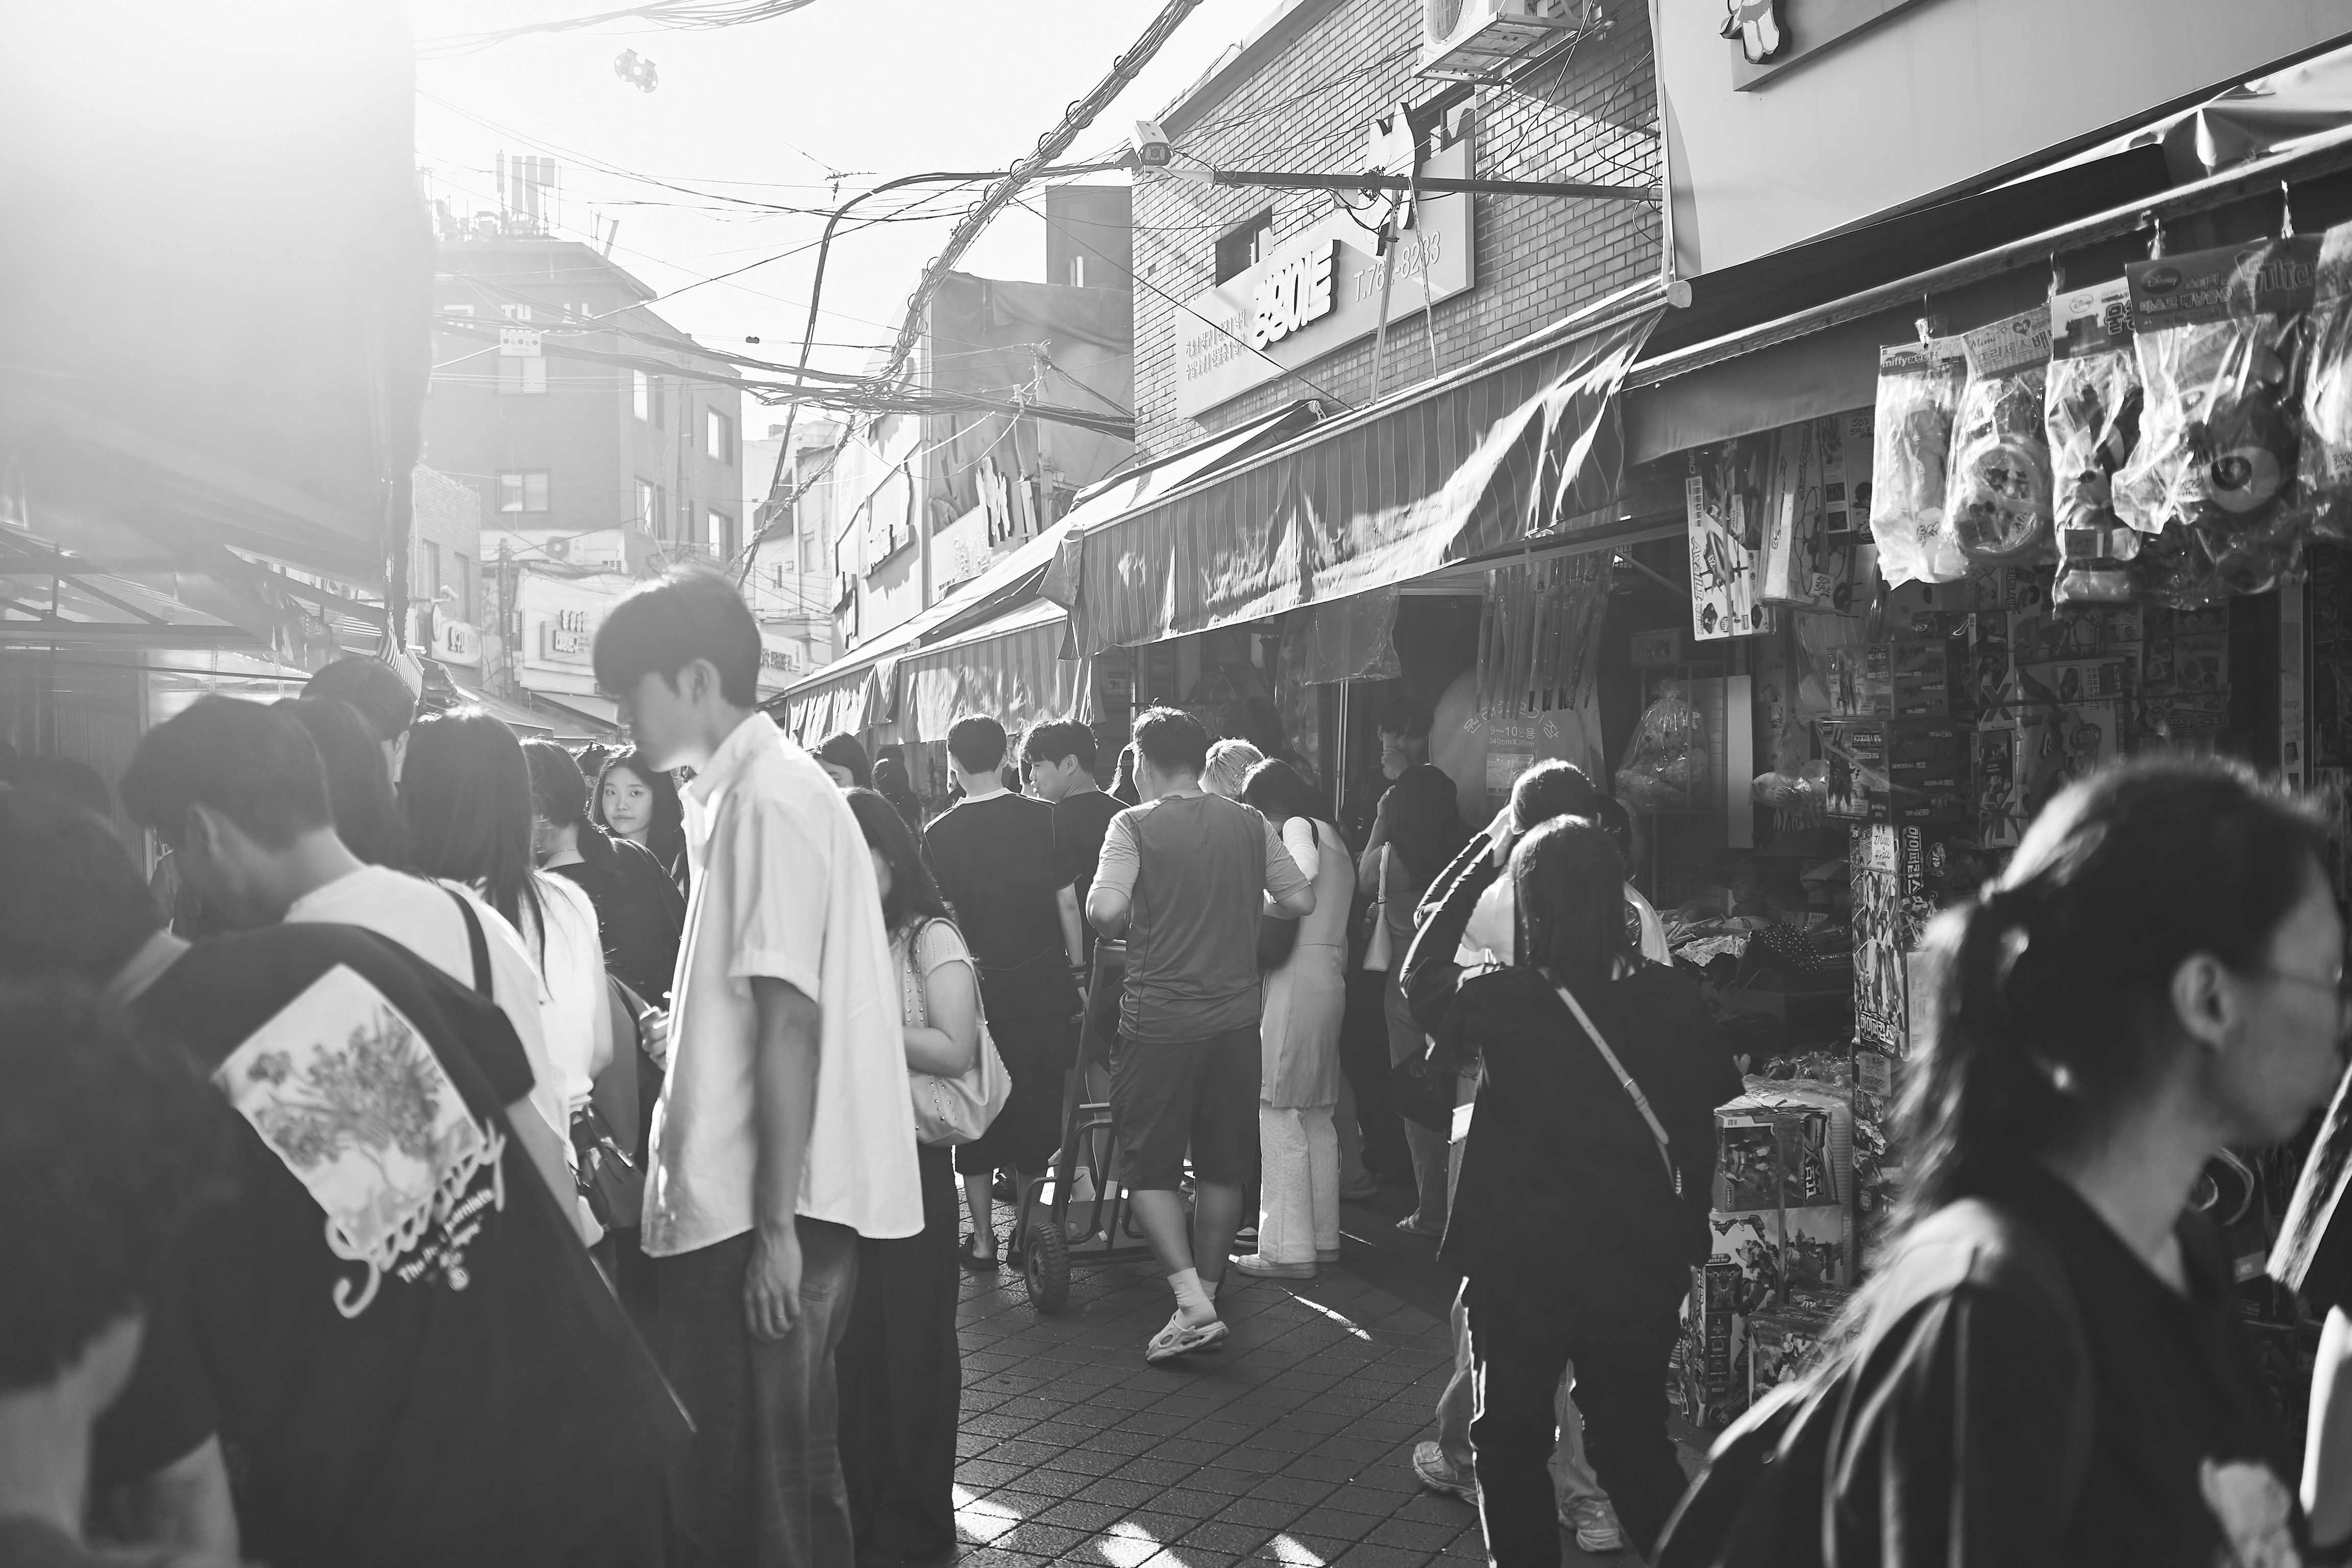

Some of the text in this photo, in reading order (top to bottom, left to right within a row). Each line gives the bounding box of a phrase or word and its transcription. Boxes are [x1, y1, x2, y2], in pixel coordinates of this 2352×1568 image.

[1354, 231, 1440, 302] T.76-8233
[1968, 334, 1996, 351] Mimi
[2031, 327, 2053, 349] 배
[1882, 355, 1908, 369] miffy
[1851, 418, 1870, 427] 50%
[1849, 427, 1872, 435] SALE
[1815, 576, 1831, 584] 50%
[1814, 584, 1831, 593] SALE
